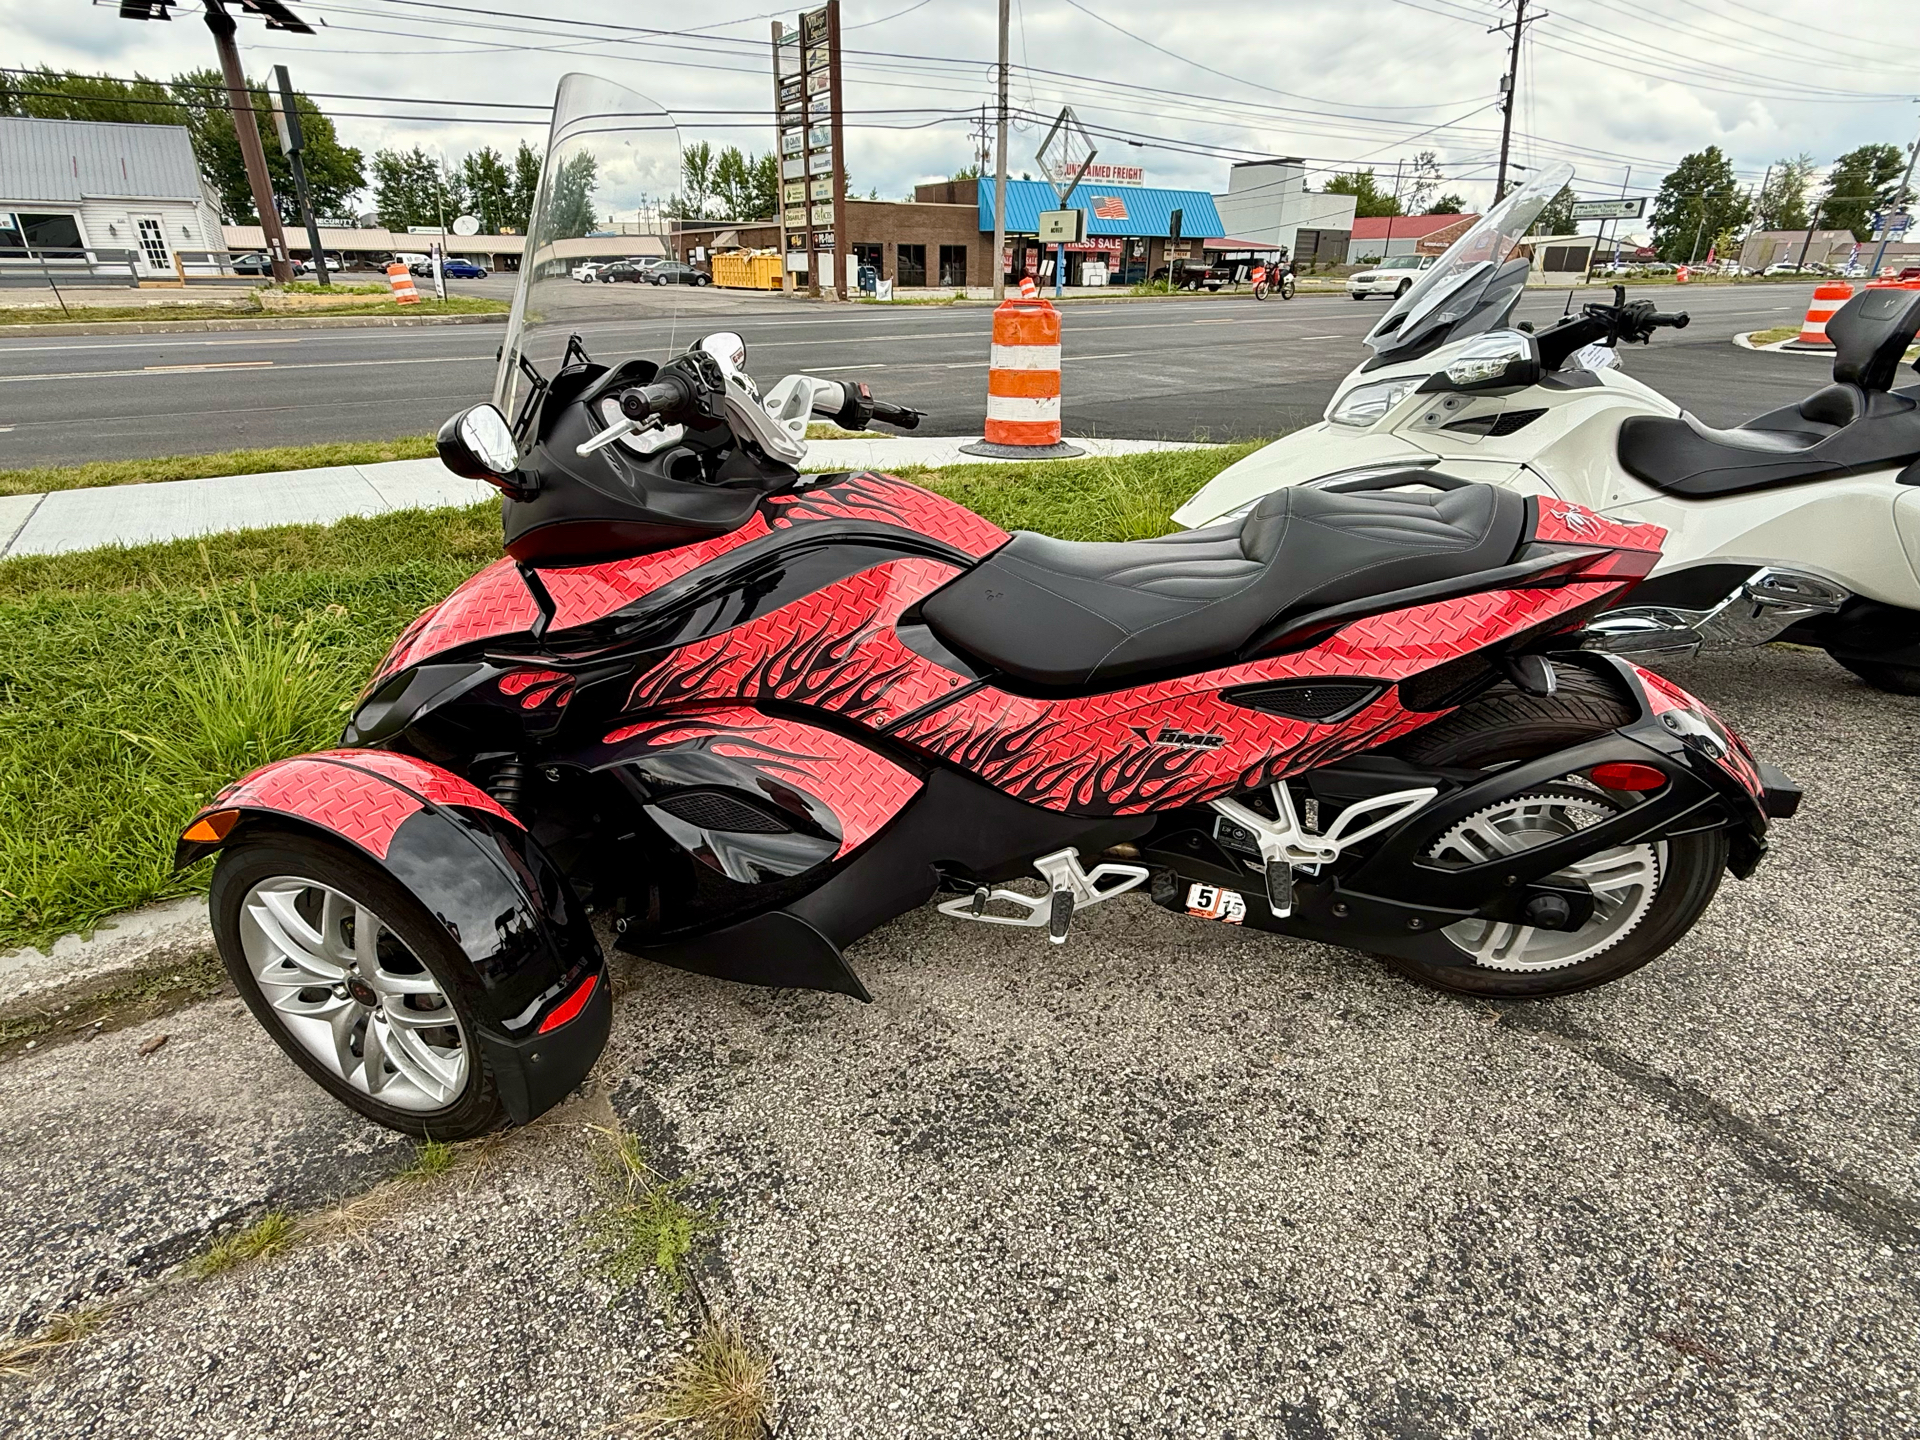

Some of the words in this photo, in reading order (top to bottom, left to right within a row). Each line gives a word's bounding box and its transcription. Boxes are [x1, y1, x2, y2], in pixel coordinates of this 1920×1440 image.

[1112, 166, 1143, 180] FREIGHT
[1097, 238, 1121, 249] SALE
[1109, 257, 1120, 265] SALE
[1197, 888, 1213, 908] 5
[1223, 900, 1243, 916] 15
